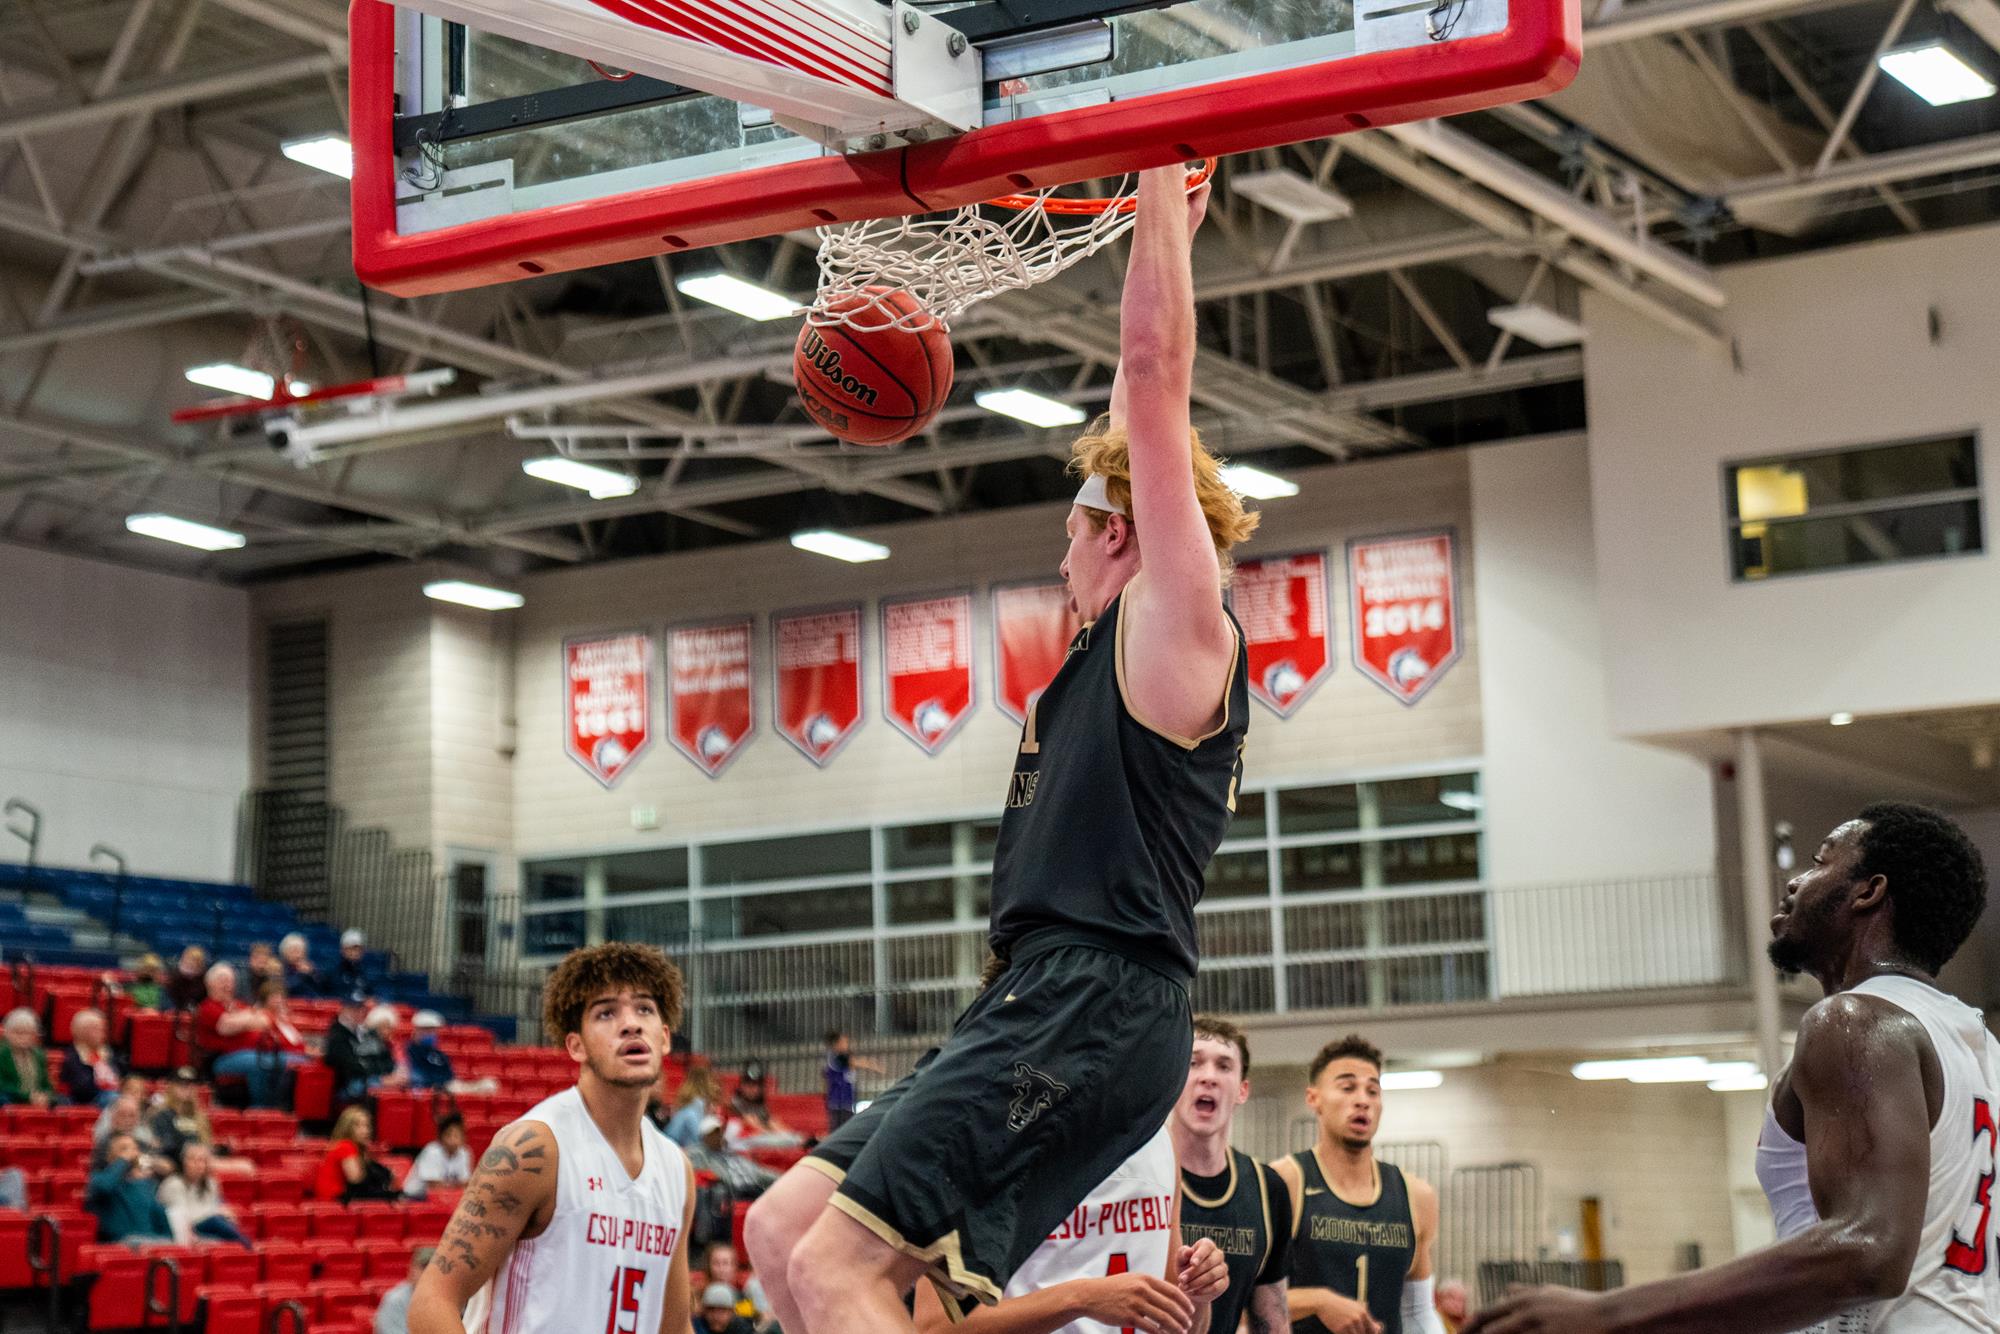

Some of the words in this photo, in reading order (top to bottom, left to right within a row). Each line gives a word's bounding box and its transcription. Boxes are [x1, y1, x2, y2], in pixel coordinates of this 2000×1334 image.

[801, 328, 879, 407] Wilson
[1365, 600, 1445, 638] 2014
[1311, 1215, 1409, 1248] MOUNTAIN
[605, 1264, 647, 1334] 15
[1355, 1253, 1369, 1304] 1
